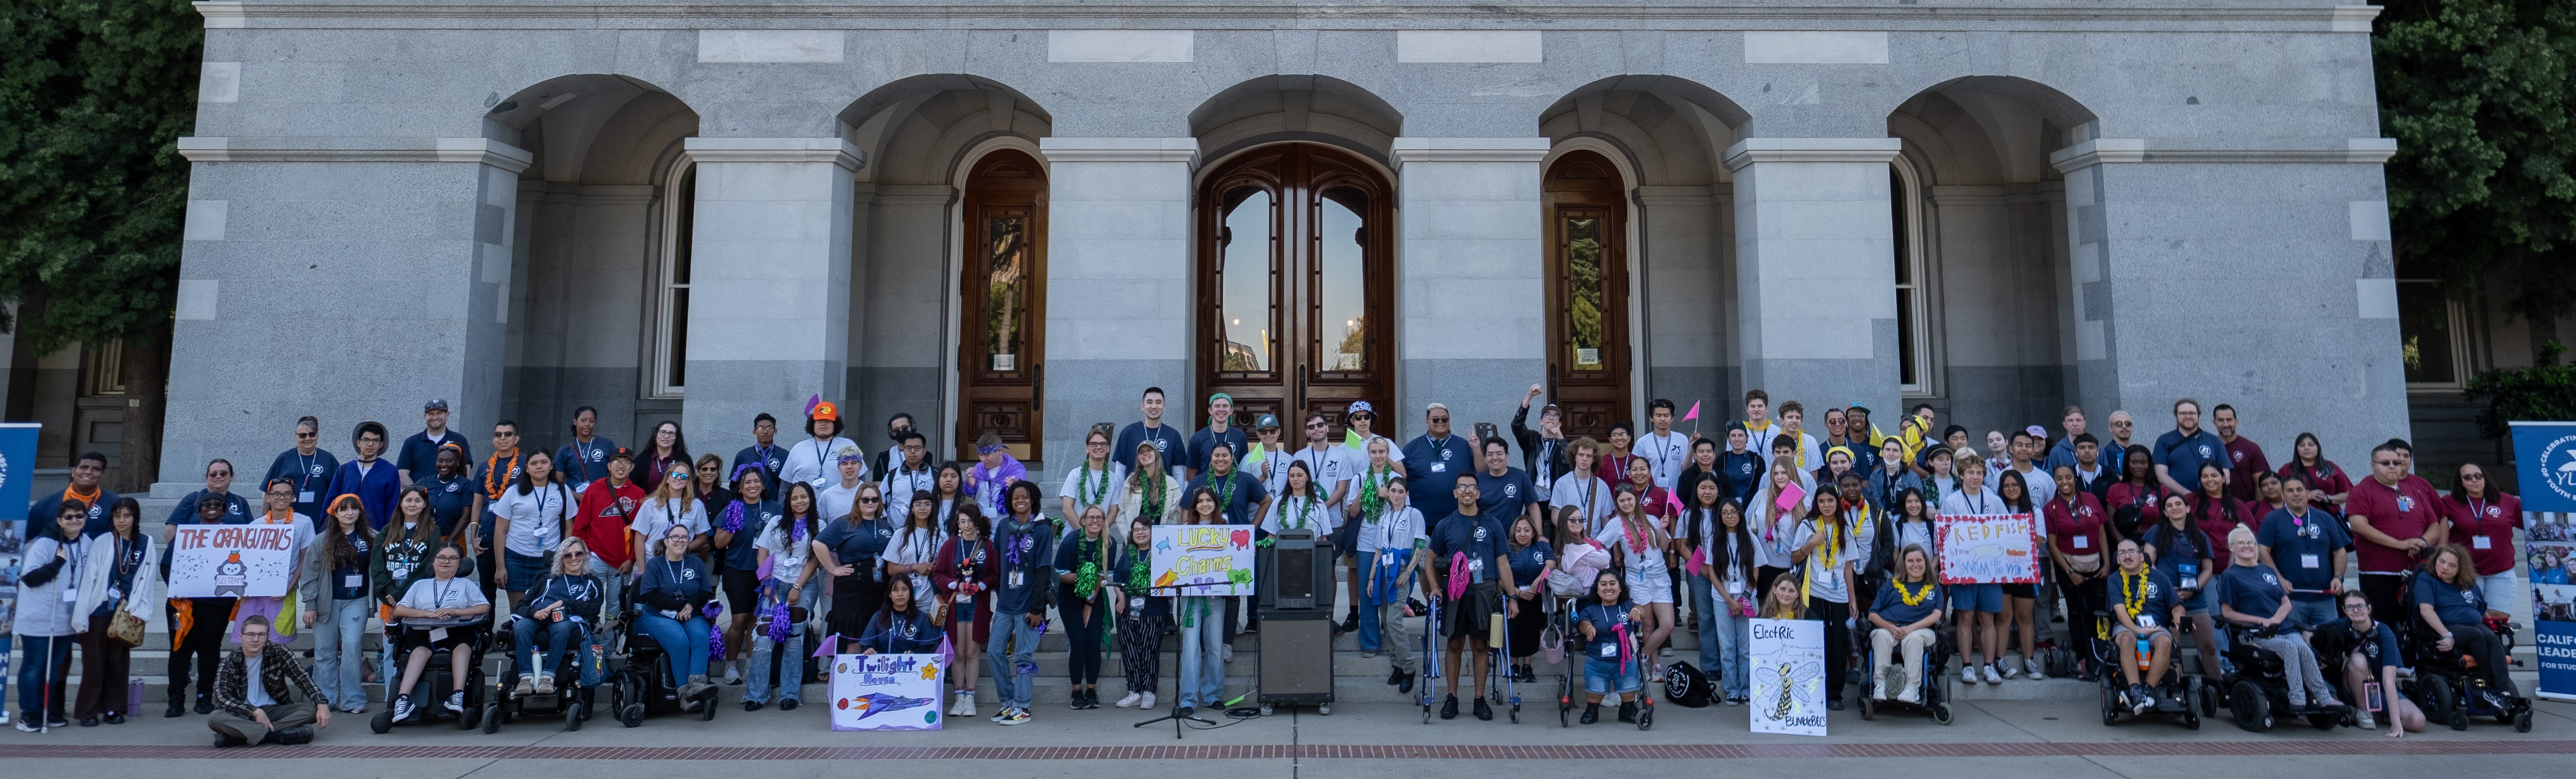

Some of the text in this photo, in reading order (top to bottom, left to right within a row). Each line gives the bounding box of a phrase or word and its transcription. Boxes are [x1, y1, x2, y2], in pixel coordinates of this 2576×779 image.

[2541, 467, 2571, 499] OF YOUTH
[180, 528, 291, 550] THE ORANGUTANS
[1176, 555, 1233, 577] Charms
[2537, 634, 2576, 645] CALIF
[855, 655, 916, 675] Twilight
